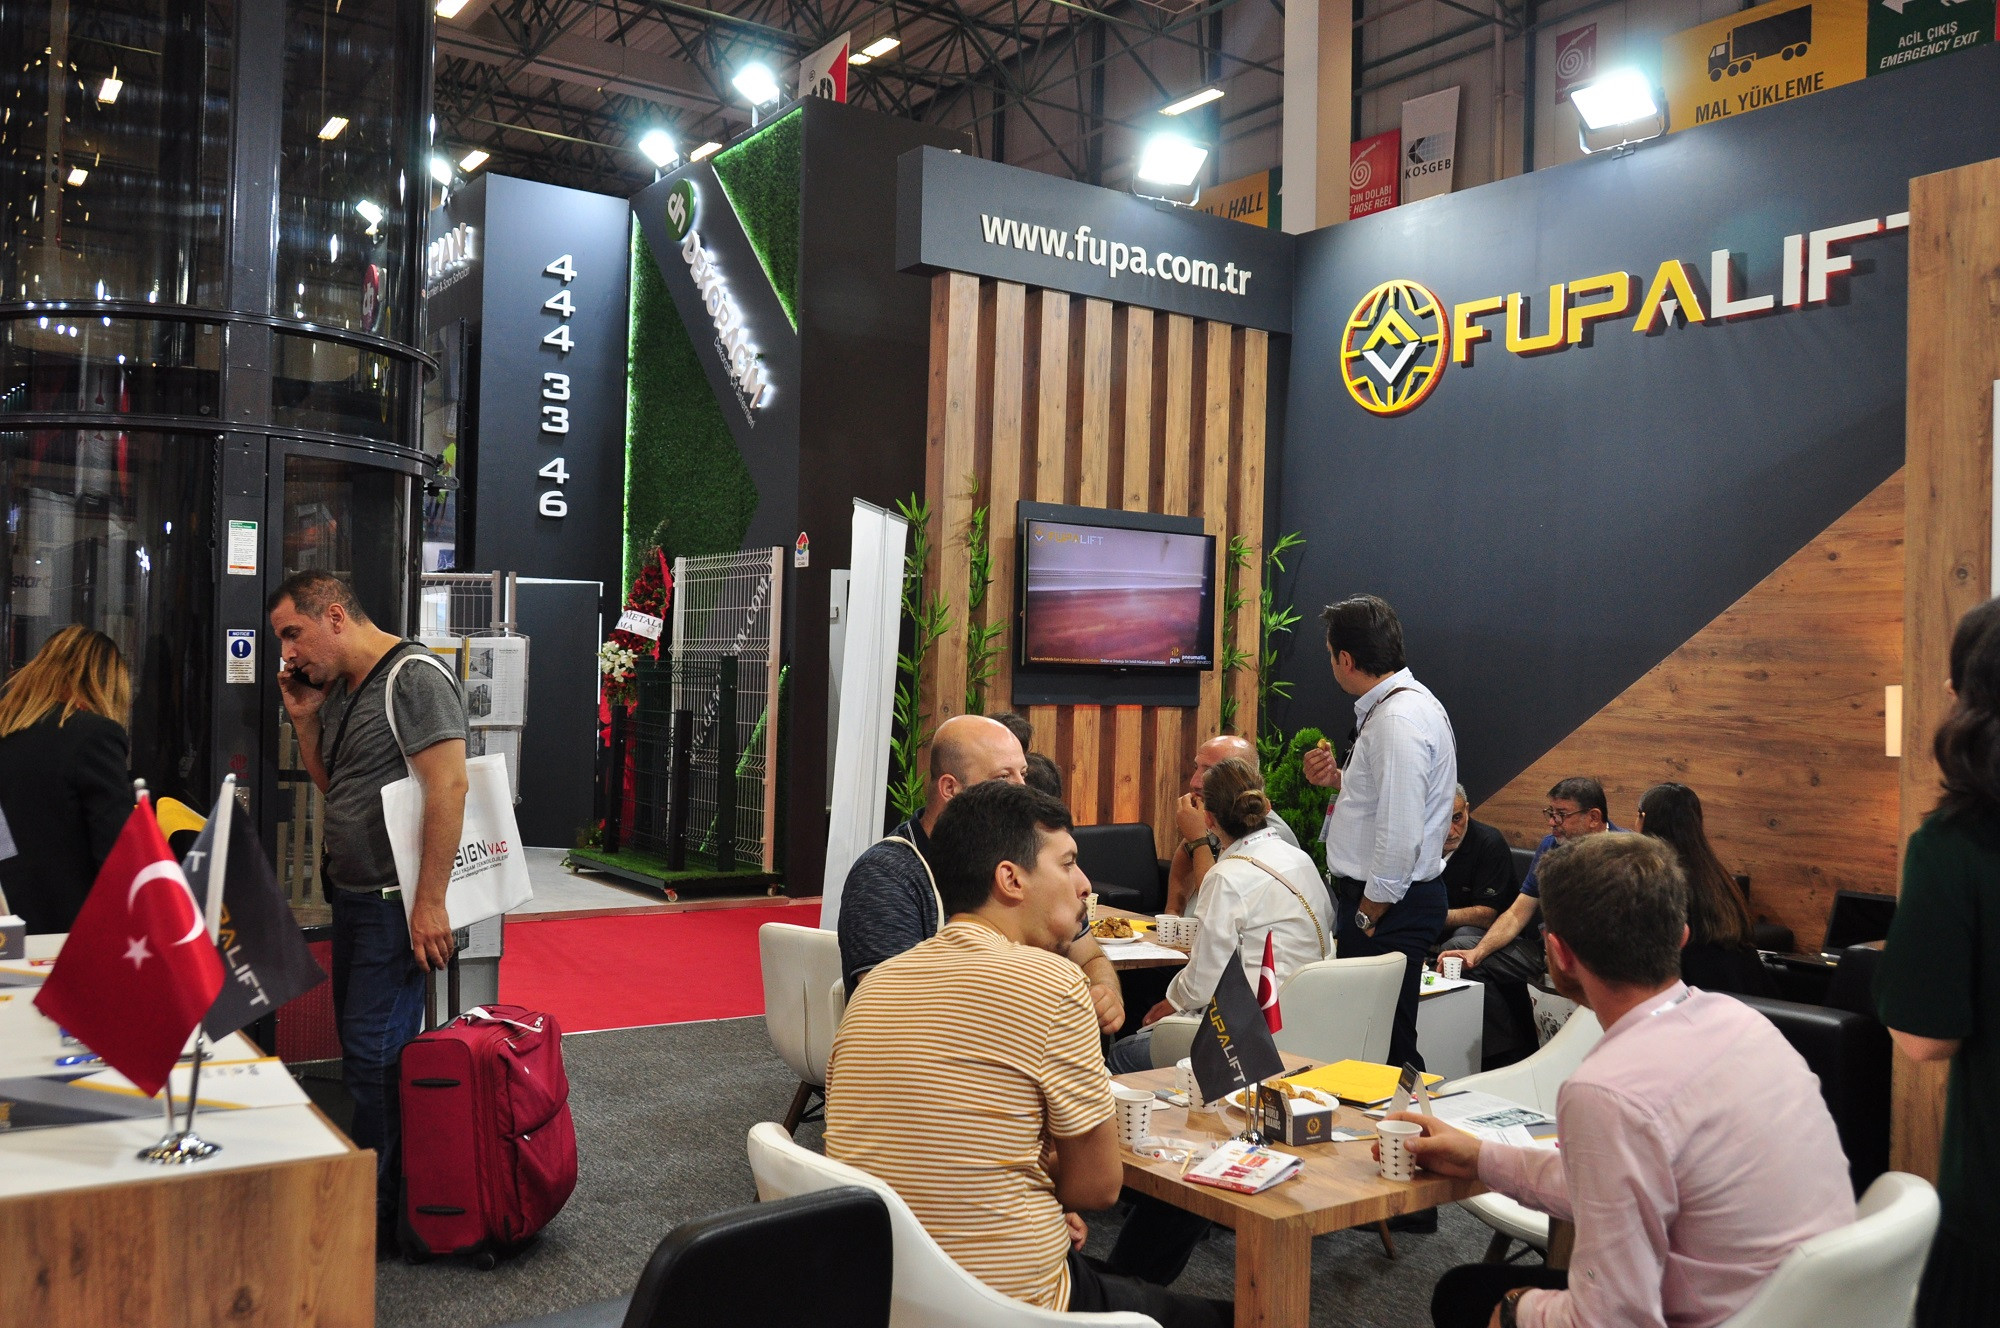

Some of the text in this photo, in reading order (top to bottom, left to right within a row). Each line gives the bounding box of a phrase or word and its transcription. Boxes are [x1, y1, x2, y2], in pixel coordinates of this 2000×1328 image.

[1898, 21, 1958, 48] ACİL ÇIKIŞ
[1880, 30, 1979, 69] EMERGENCY EXIT
[1695, 71, 1824, 123] MAL YÜKLEME
[1405, 158, 1451, 179] KOSGEB
[1229, 192, 1263, 218] HALL
[1353, 201, 1373, 214] HOSE
[1374, 196, 1393, 209] REEL
[1365, 185, 1392, 200] DOLABI
[981, 213, 1252, 296] www.fupa.com.tr
